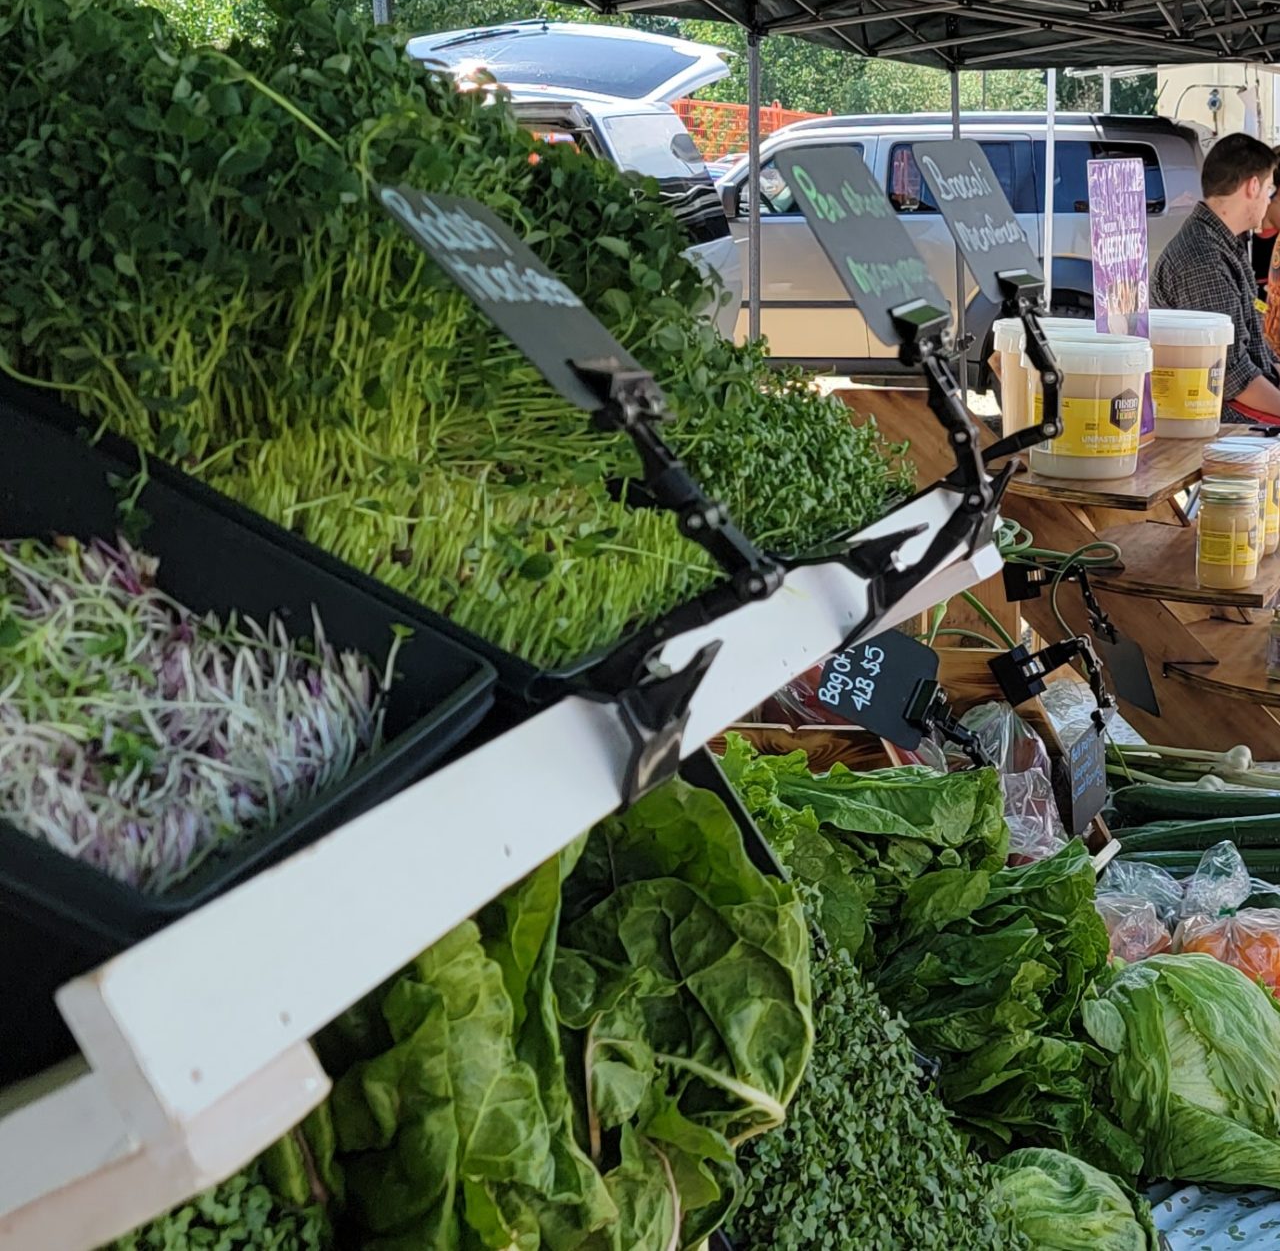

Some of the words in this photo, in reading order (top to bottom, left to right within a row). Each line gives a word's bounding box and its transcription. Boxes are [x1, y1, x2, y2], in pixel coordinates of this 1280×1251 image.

[792, 164, 847, 224] Pea
[860, 645, 885, 677] $5
[818, 672, 854, 706] Bag
[851, 676, 875, 711] 4LB
